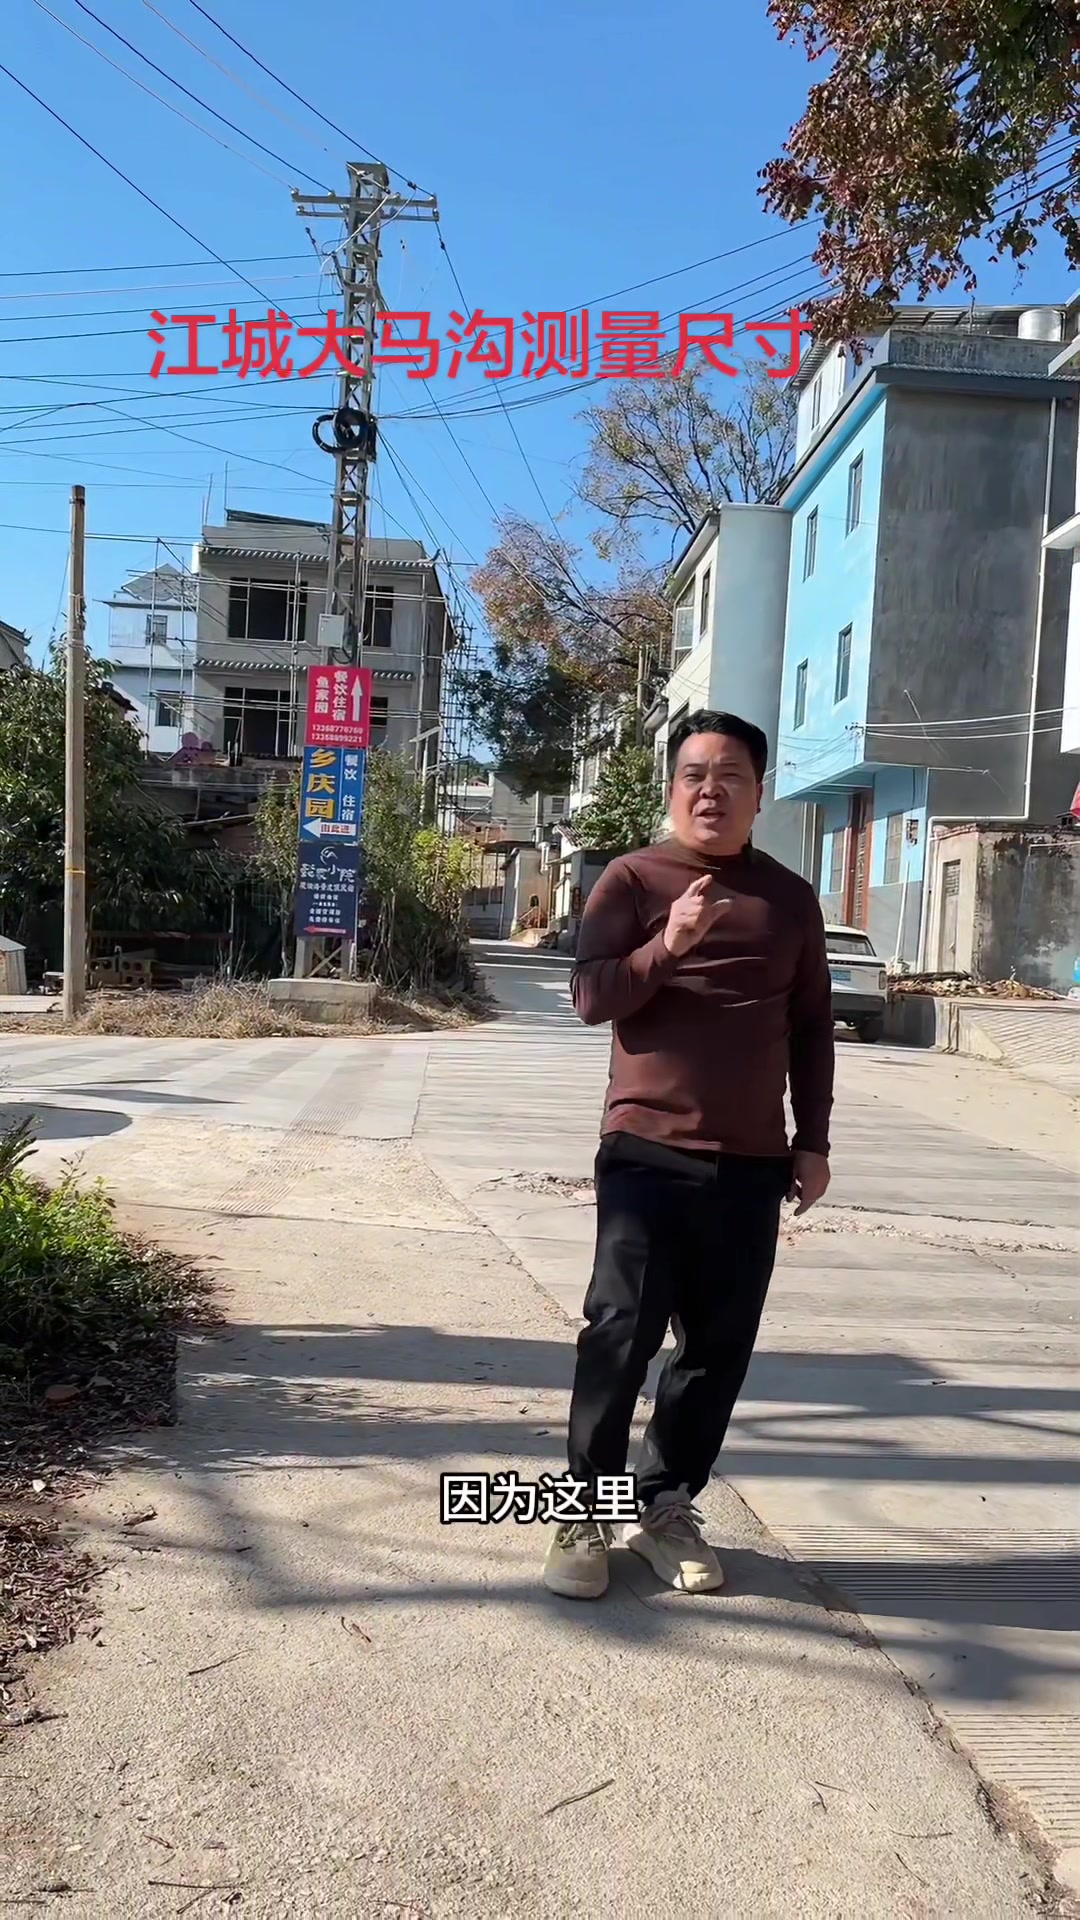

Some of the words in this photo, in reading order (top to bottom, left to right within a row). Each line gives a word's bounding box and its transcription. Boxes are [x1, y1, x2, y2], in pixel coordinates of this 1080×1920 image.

[332, 670, 348, 722] 餐饮住宿
[305, 748, 337, 819] 乡庆园
